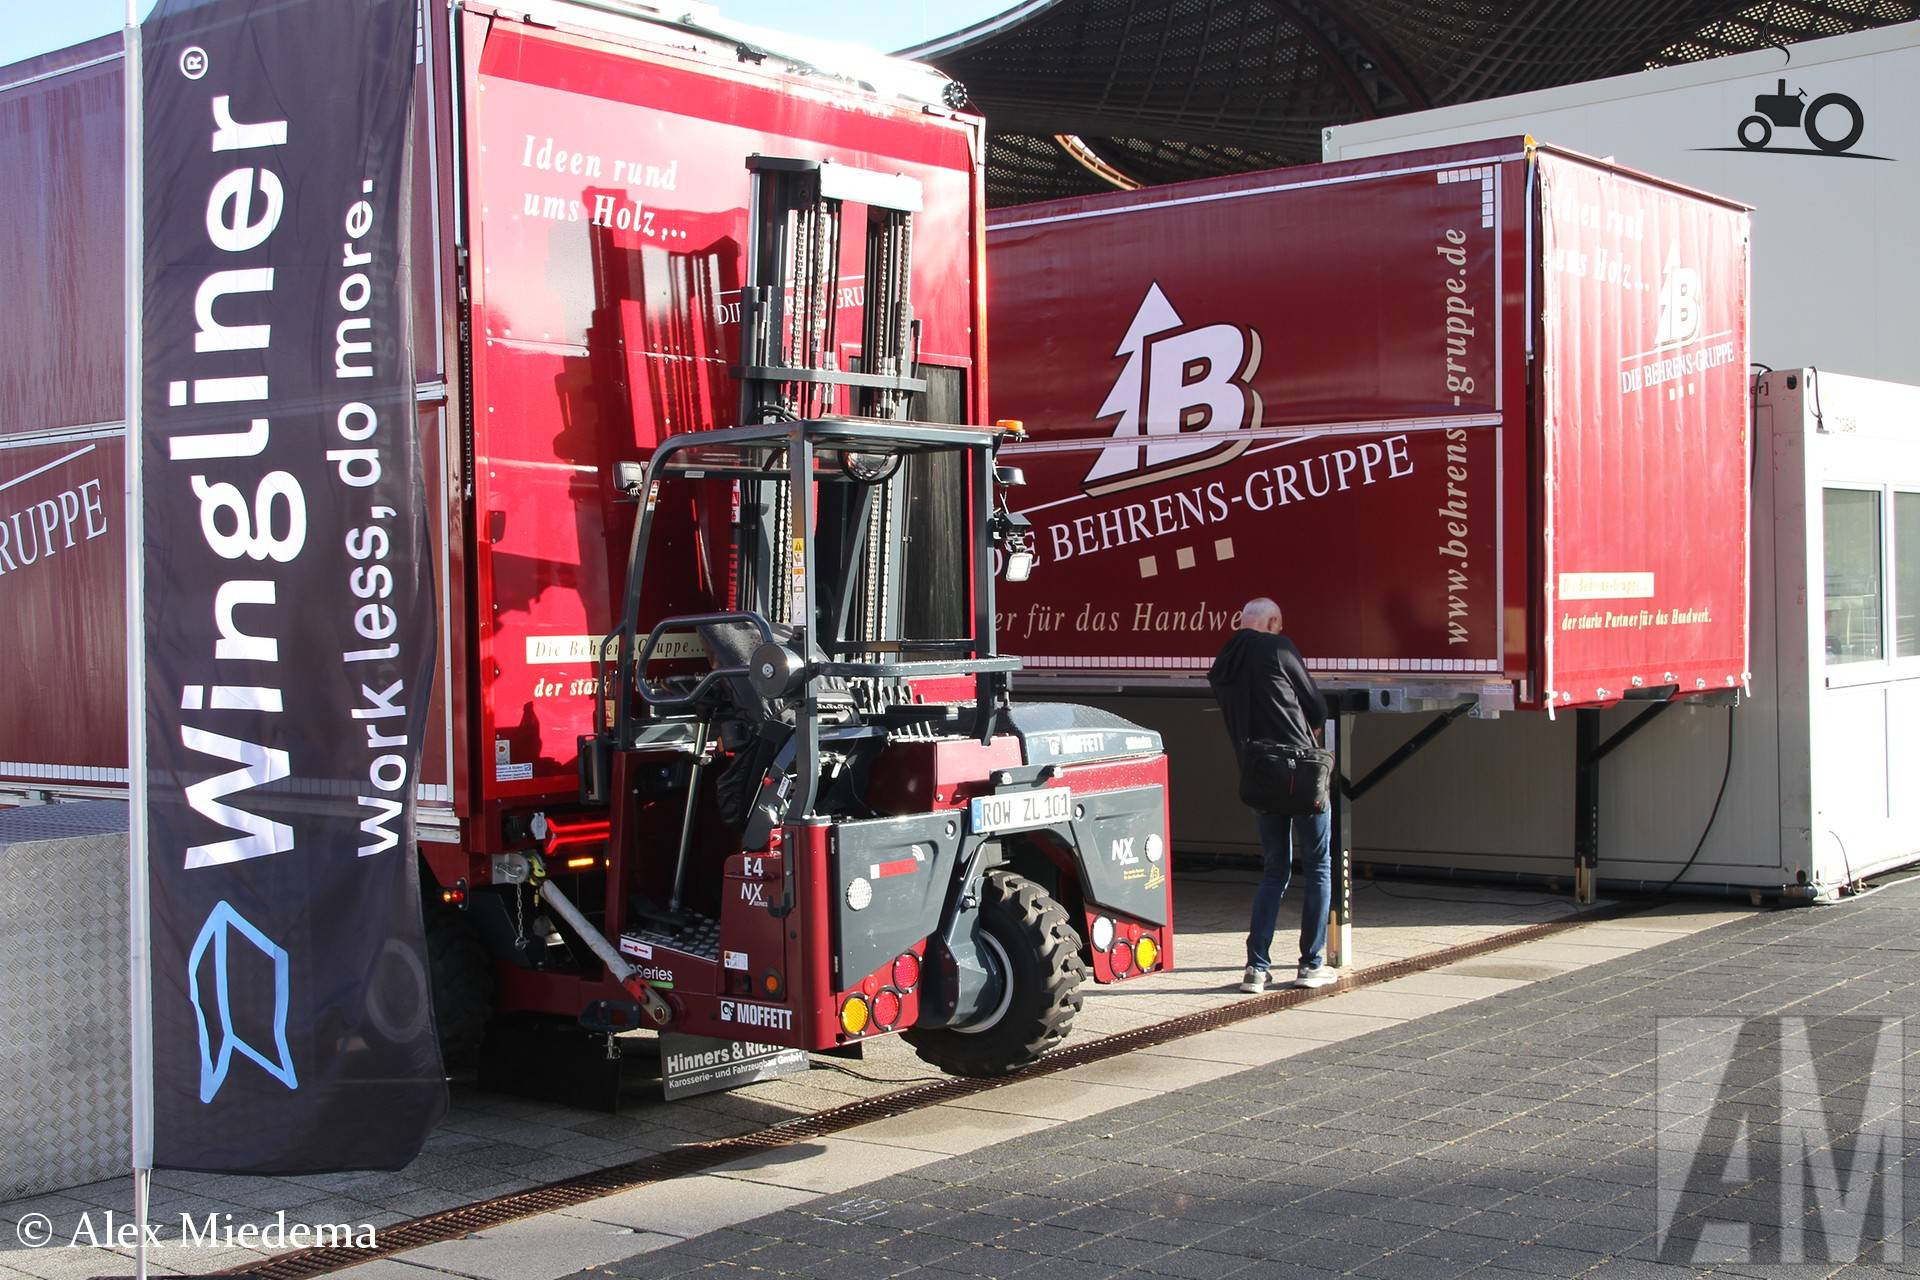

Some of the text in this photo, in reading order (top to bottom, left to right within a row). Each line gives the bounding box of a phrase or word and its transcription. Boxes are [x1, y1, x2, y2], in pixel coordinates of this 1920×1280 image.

[522, 134, 678, 191] Ideen rund
[524, 193, 580, 223] ums
[1621, 341, 1735, 394] DIE BEHRENS-GRUPPE
[1437, 228, 1476, 646] www.behrens-gruppe.de
[168, 94, 307, 870] Wingliner
[1049, 434, 1415, 564] BEHRENS-GRUPPE
[326, 178, 409, 858] work less, do more.
[1023, 603, 1066, 640] für
[1075, 603, 1120, 632] das
[1132, 602, 1243, 632] Handwe
[1561, 613, 1579, 631] der
[1578, 612, 1602, 630] starke
[1605, 611, 1638, 628] Partner
[1638, 609, 1654, 630] für
[1656, 609, 1669, 626] das
[533, 678, 563, 698] der
[983, 793, 1069, 827] ROW ZL 101
[743, 856, 764, 877] E4
[1111, 837, 1134, 866] NX
[740, 882, 764, 906] NX
[737, 1003, 793, 1030] MOFFETT
[667, 1048, 730, 1074] Hinners
[732, 1041, 744, 1060] &
[669, 1073, 714, 1089] Karosserie-
[715, 1066, 731, 1079] und
[777, 1052, 803, 1064] GmbH
